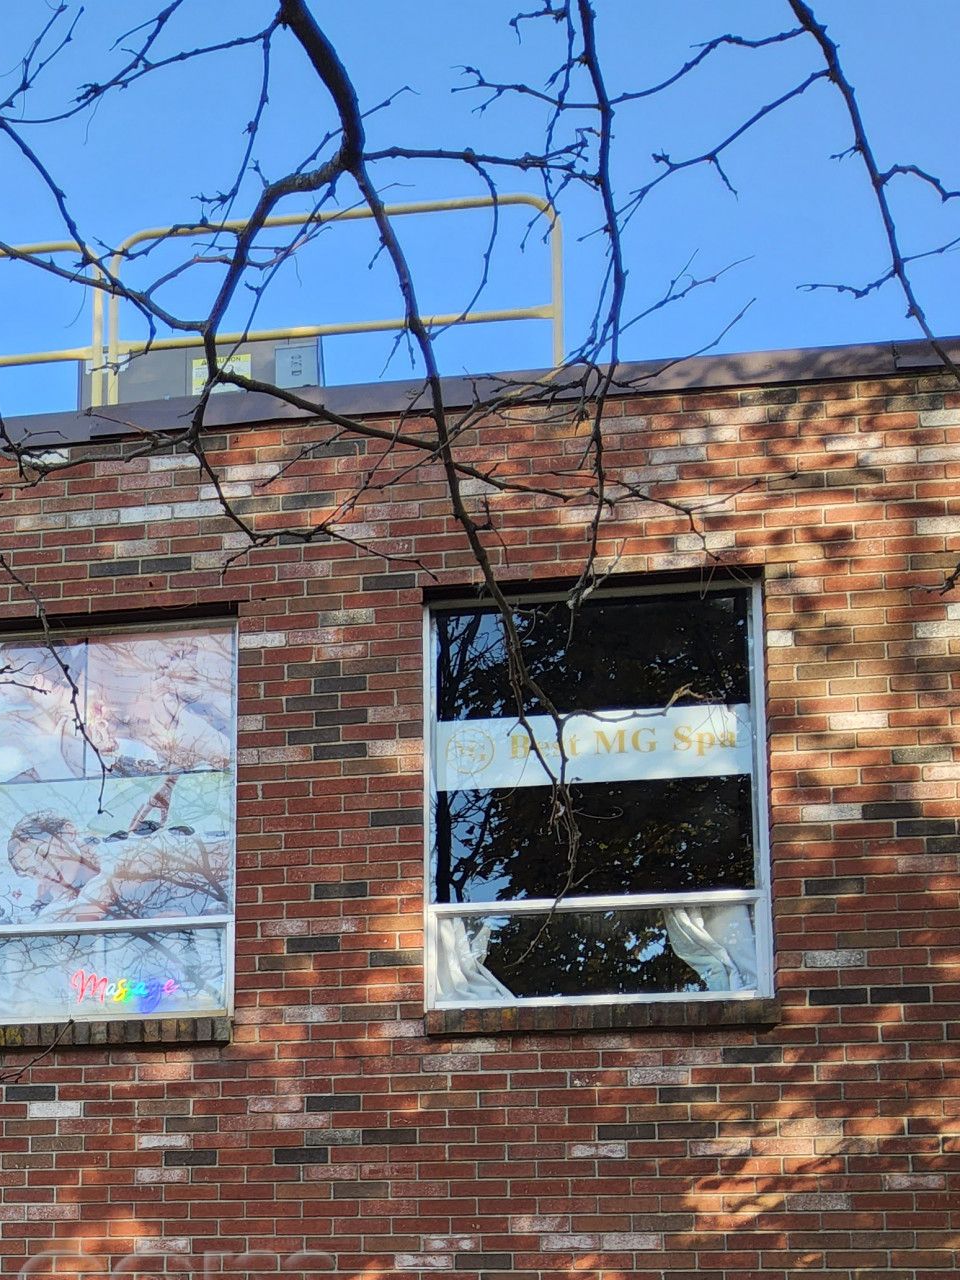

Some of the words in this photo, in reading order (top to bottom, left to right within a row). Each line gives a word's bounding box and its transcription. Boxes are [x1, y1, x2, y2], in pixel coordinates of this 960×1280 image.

[594, 727, 657, 755] MG
[673, 725, 737, 756] Spa
[71, 968, 179, 1014] Massage
